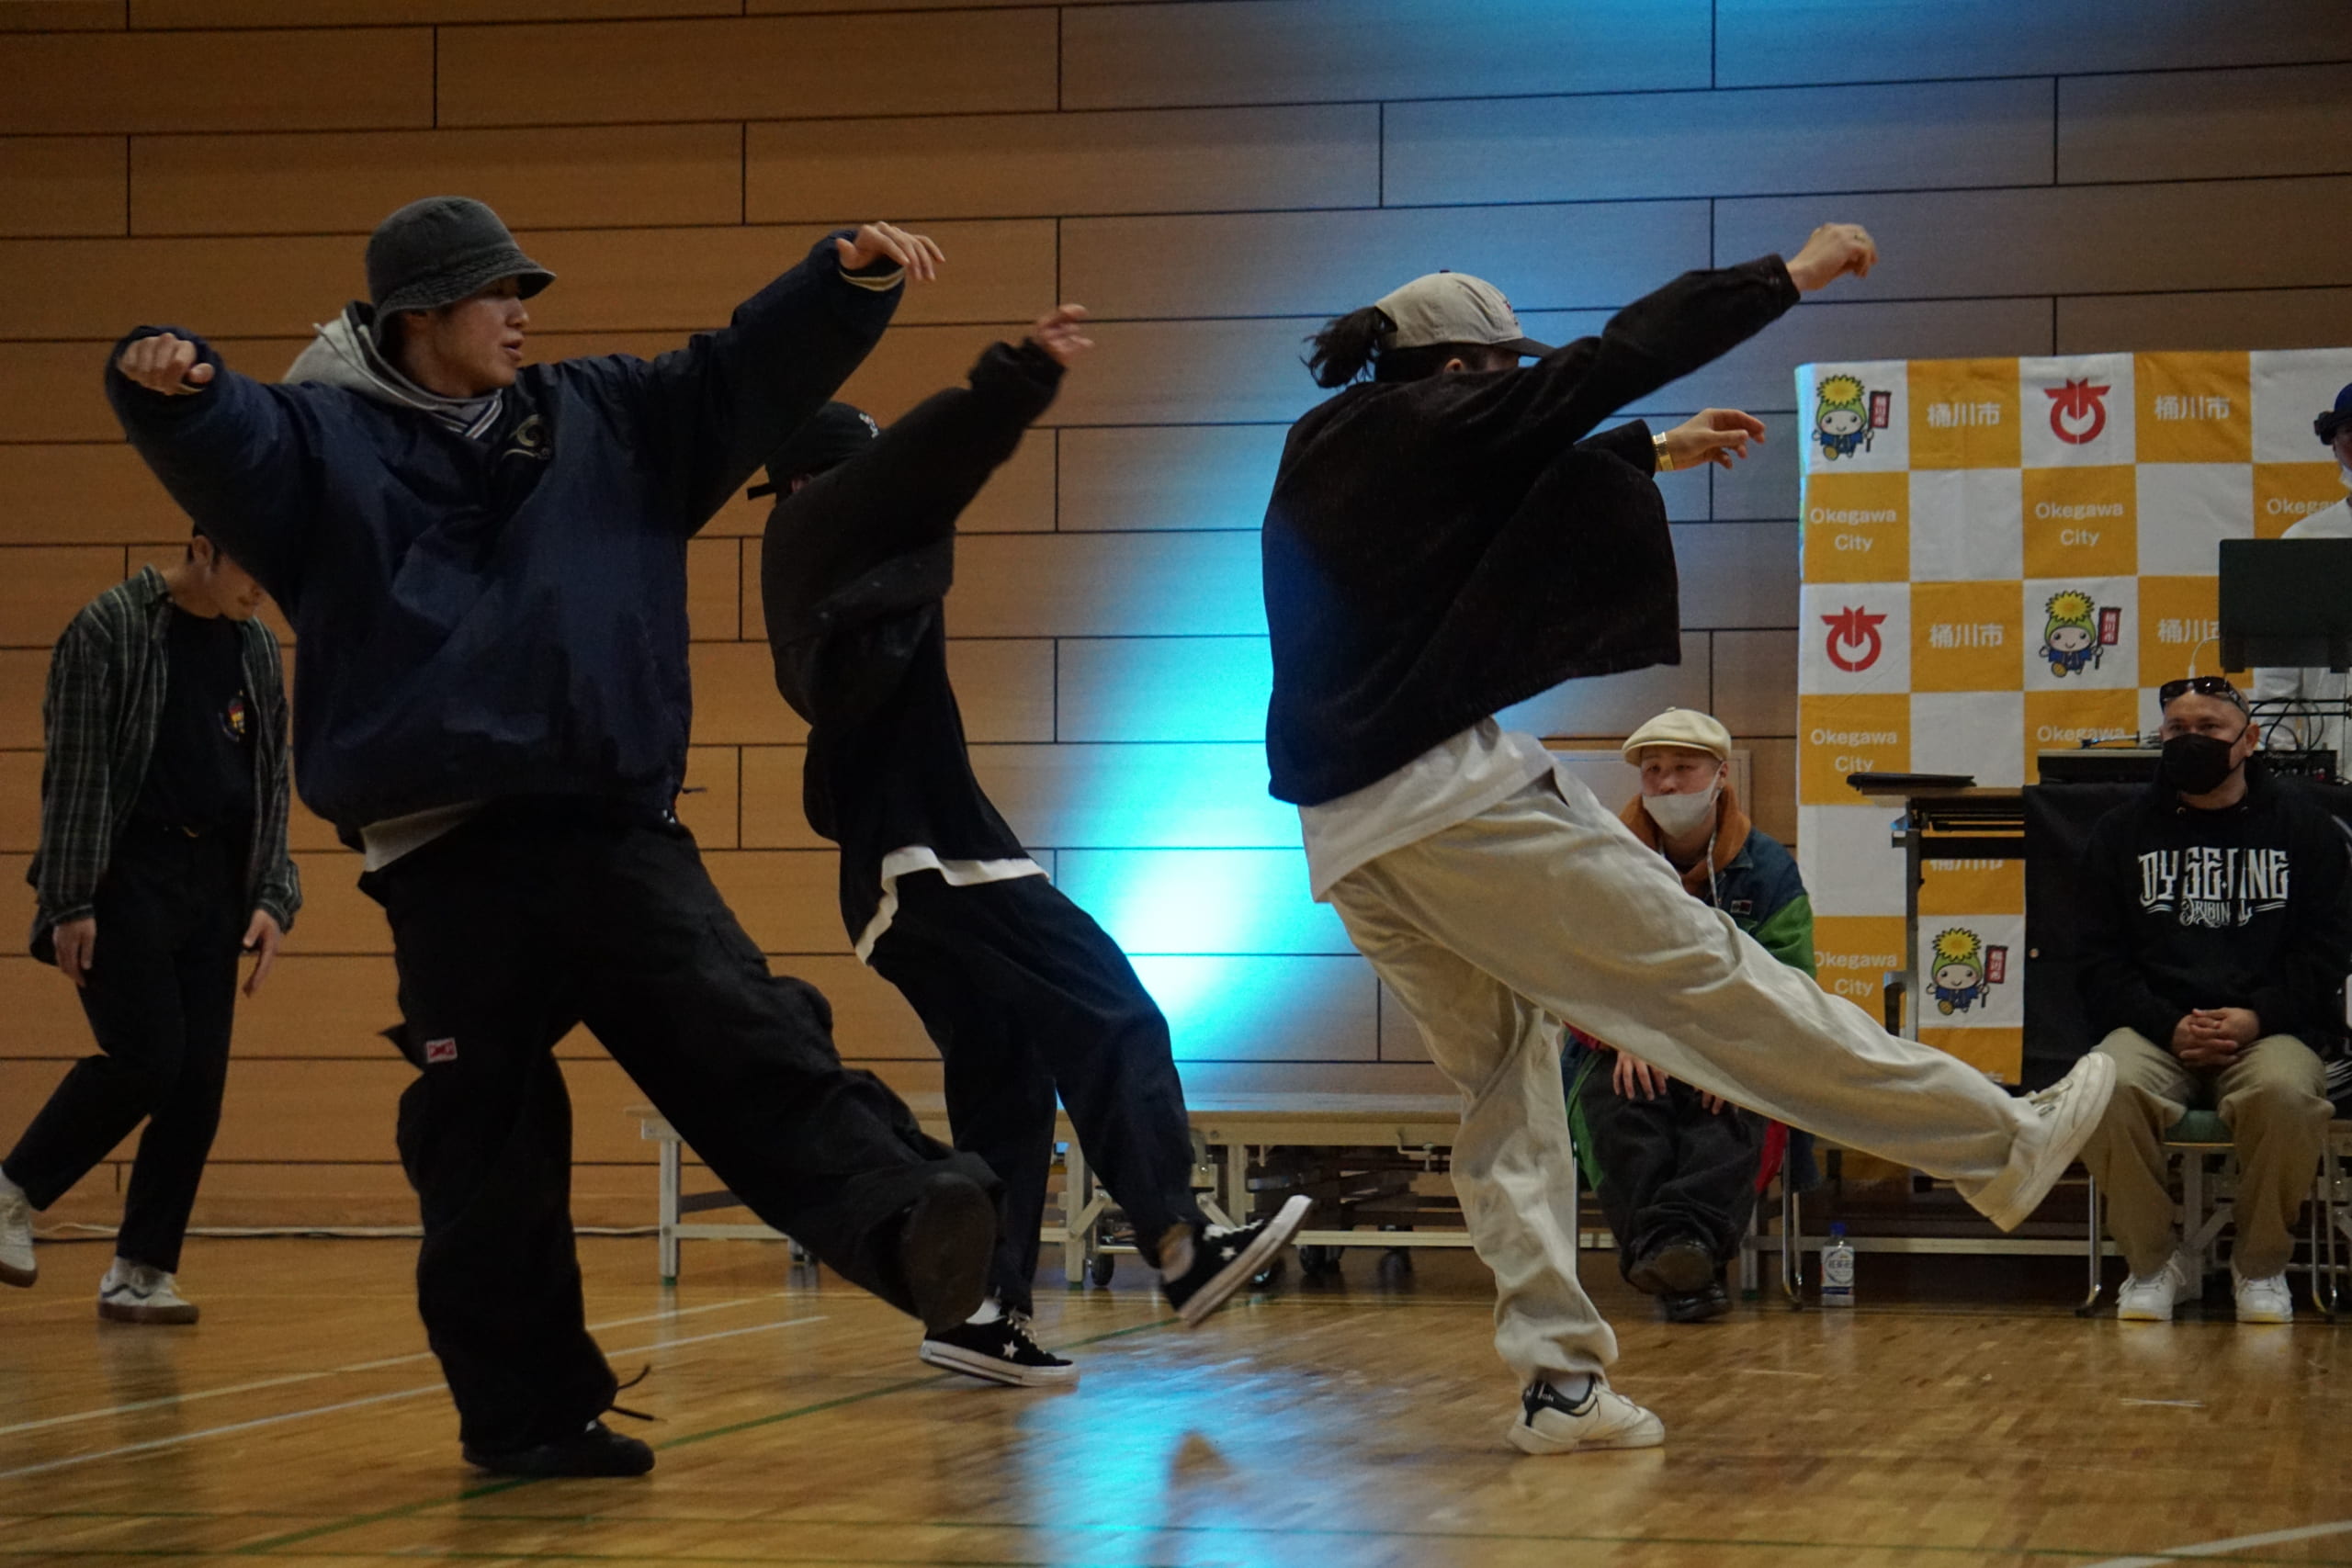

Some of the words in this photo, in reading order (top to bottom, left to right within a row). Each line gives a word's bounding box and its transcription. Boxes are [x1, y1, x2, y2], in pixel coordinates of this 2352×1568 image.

[1927, 401, 2000, 428] 桶川市
[2154, 395, 2231, 420] 桶川市
[1810, 507, 1897, 526] Okegawa
[2035, 502, 2124, 520] Okegawa
[1835, 535, 1873, 553] City
[2061, 528, 2100, 547] City
[1929, 623, 2004, 648] 桶川市
[1810, 728, 1898, 747] Okegawa
[2037, 725, 2125, 742] Okegawa
[1835, 756, 1874, 773] City
[1814, 951, 1897, 969] Okegawa
[1834, 979, 1874, 998] City
